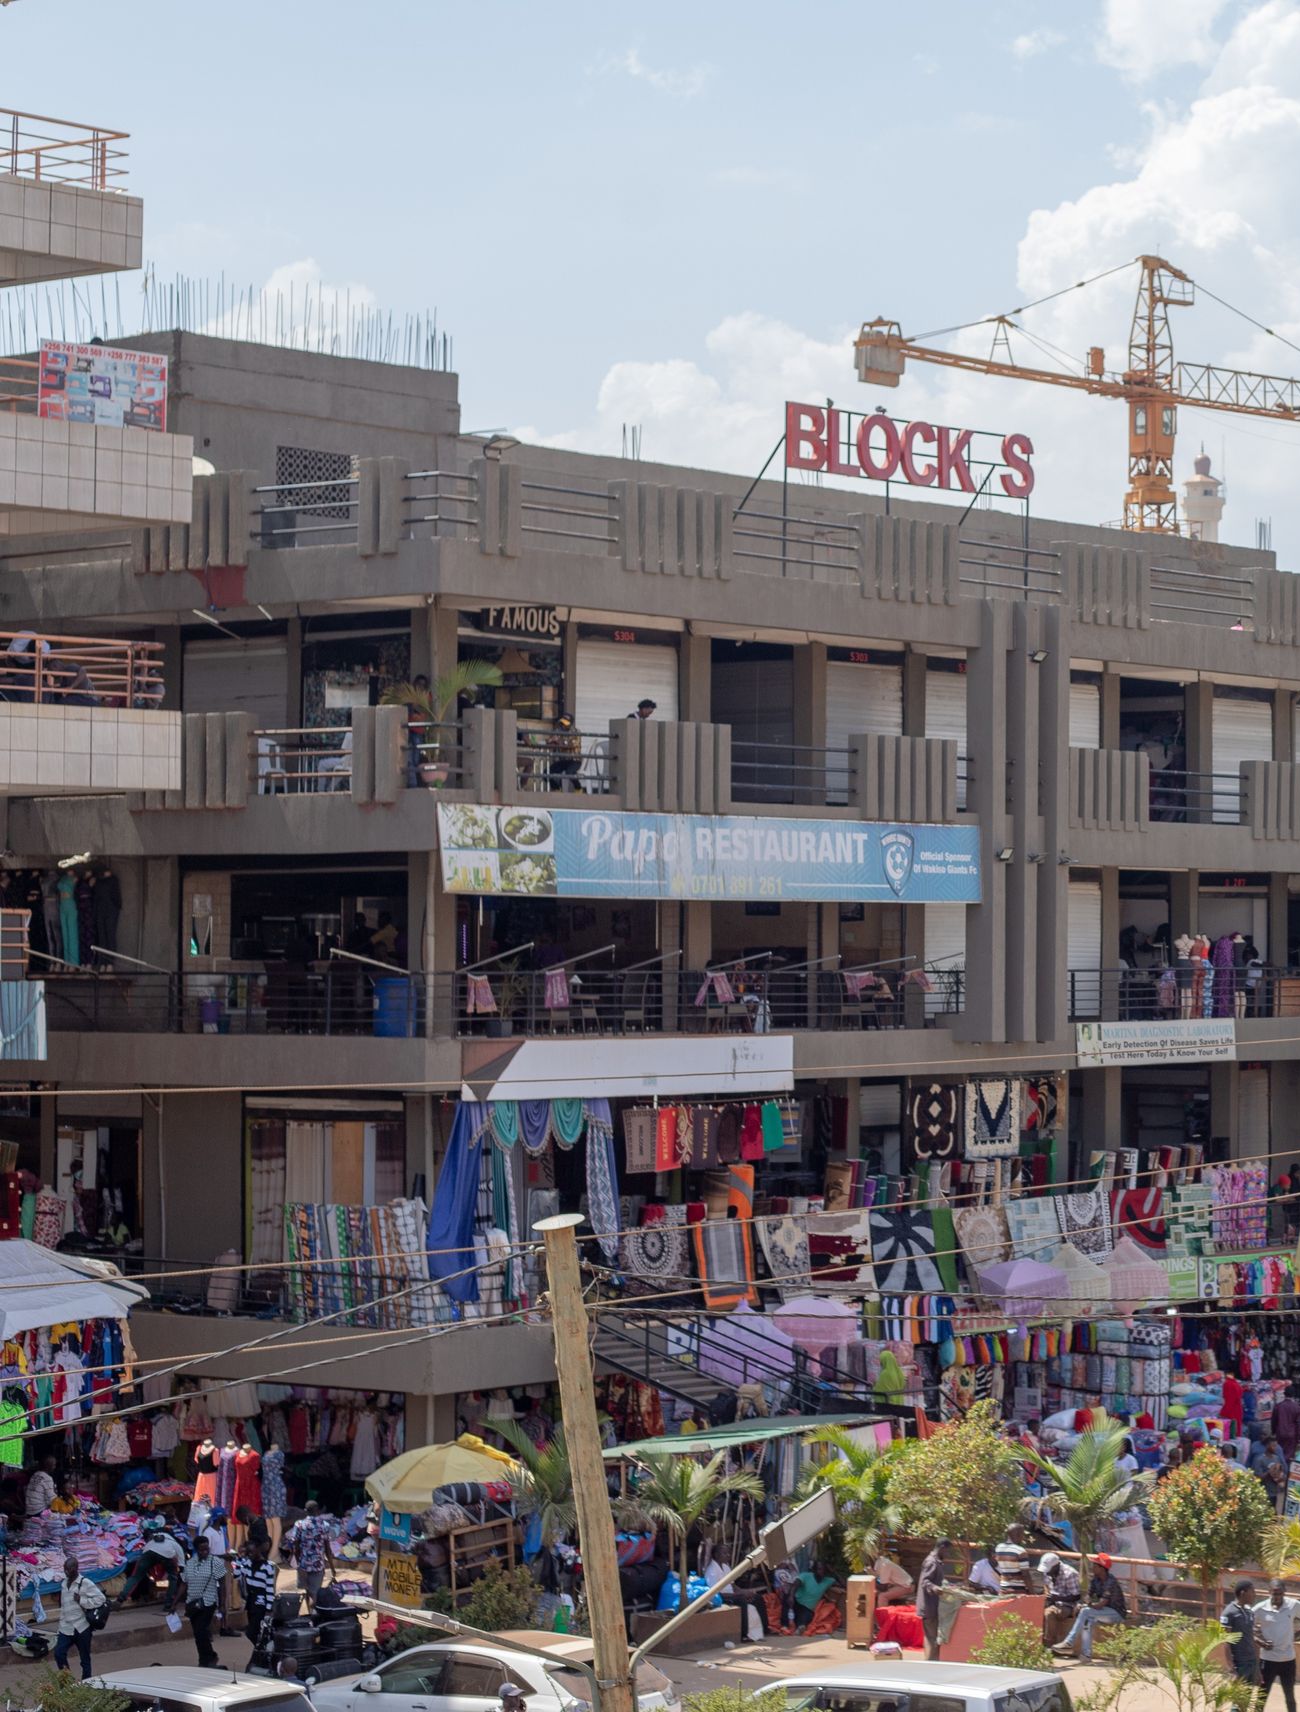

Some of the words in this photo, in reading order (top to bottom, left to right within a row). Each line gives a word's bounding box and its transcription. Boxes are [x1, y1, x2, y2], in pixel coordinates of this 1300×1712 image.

[785, 400, 977, 494] BLOCK
[999, 432, 1035, 498] S
[488, 605, 560, 635] FAMOUS
[695, 827, 869, 865] RESTAURANT
[920, 851, 944, 862] Official
[944, 852, 972, 864] Sponsor
[1102, 1041, 1122, 1051] Early
[1123, 1039, 1158, 1049] Detection
[1170, 1037, 1197, 1047] Disease
[1199, 1037, 1220, 1046] Saves
[1221, 1036, 1234, 1045] Life
[1110, 1051, 1126, 1060] Test
[1127, 1051, 1145, 1059] Here
[1146, 1050, 1168, 1059] Today
[1176, 1049, 1197, 1058] Know
[1198, 1048, 1215, 1057] Your
[1215, 1047, 1229, 1056] Self
[384, 1526, 407, 1537] wave
[387, 1558, 417, 1573] MTN
[383, 1569, 422, 1586] MOBILE
[384, 1581, 418, 1597] MONEY
